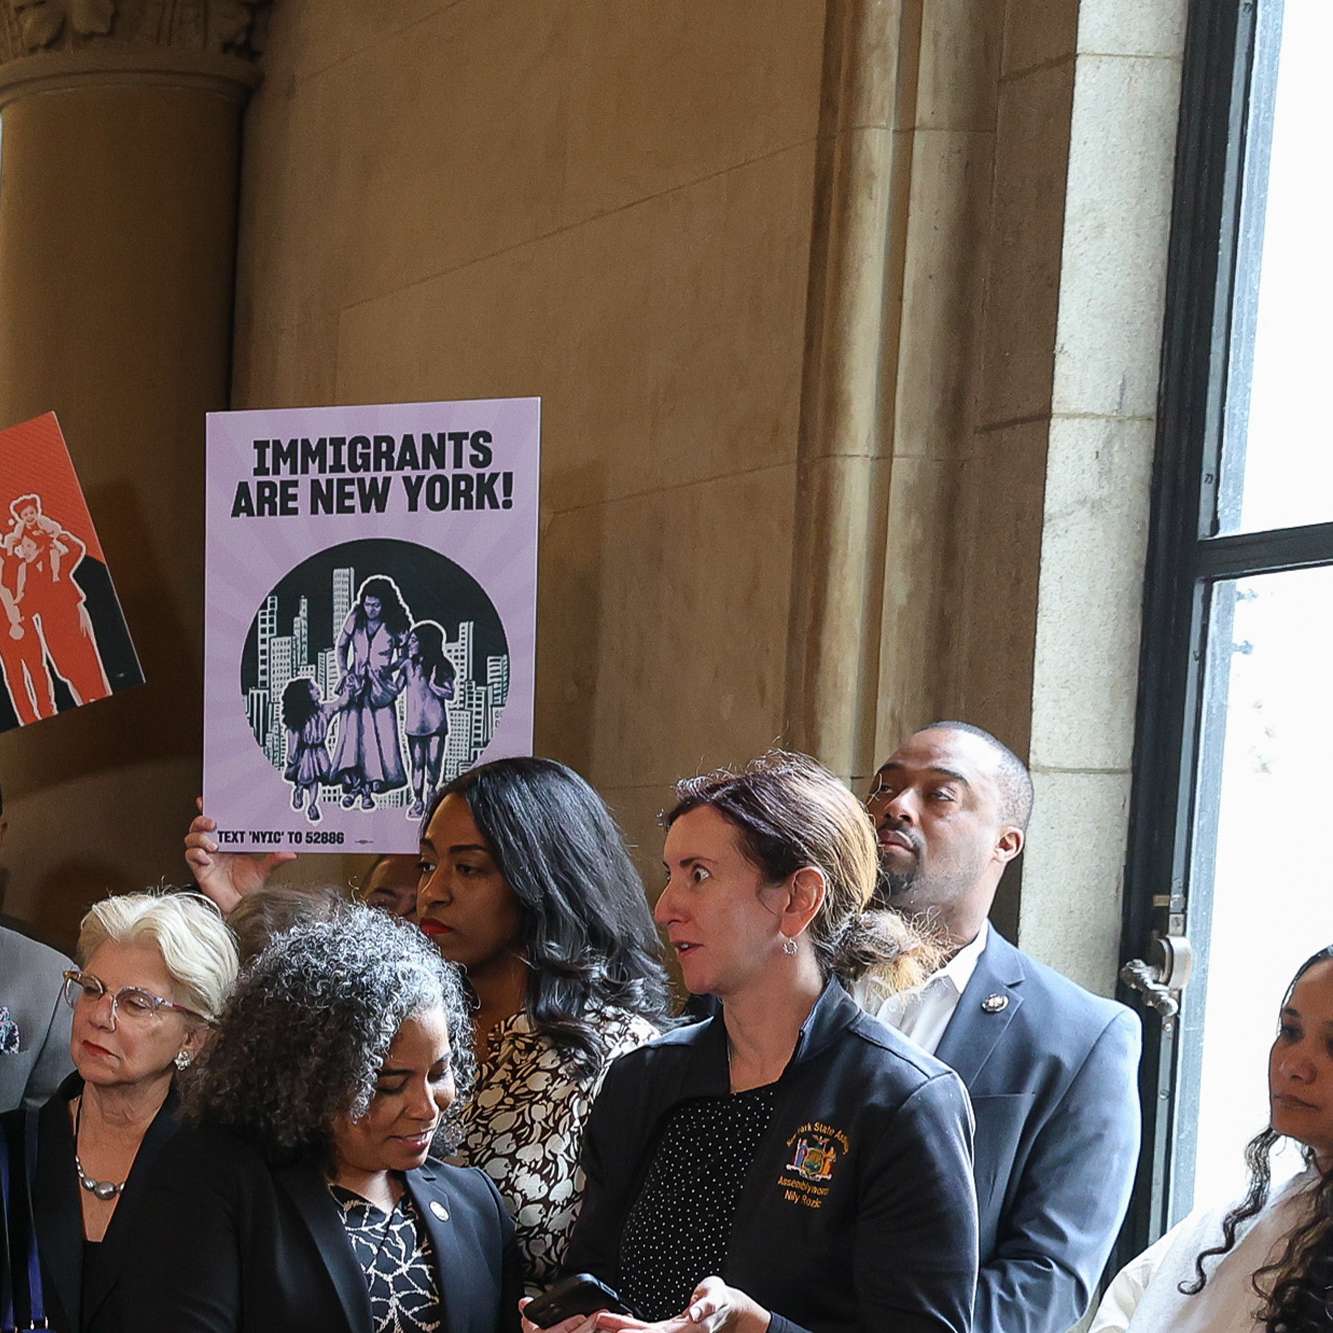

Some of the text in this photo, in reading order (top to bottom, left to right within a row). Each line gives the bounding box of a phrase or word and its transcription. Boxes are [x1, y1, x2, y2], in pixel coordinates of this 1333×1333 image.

[253, 431, 493, 476] IMMIGRANTS
[231, 472, 514, 518] ARE NEW YORK!
[217, 831, 245, 843] TEXT
[288, 831, 302, 843] TO
[305, 832, 344, 844] 52886
